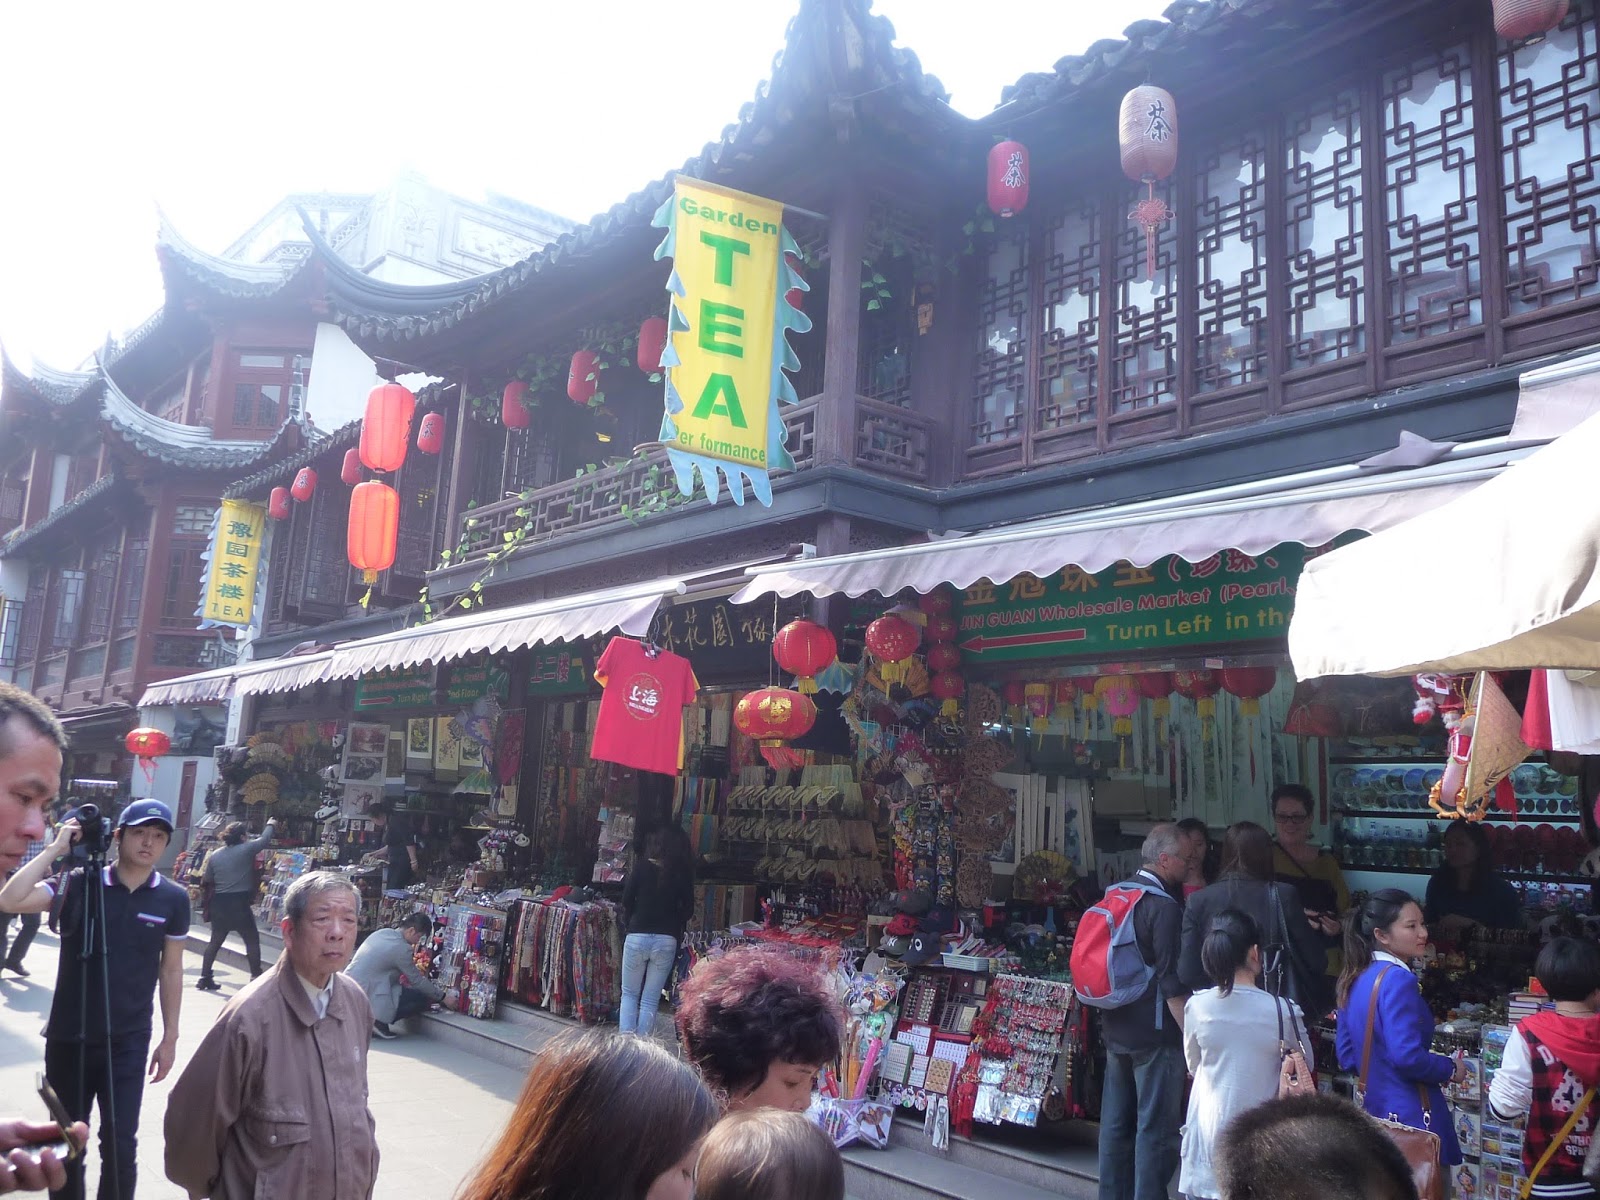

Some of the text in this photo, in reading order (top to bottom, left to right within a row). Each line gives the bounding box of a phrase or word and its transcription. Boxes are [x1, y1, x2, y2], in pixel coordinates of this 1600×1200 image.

[1144, 100, 1173, 143] 茶
[1001, 151, 1026, 188] 茶
[680, 197, 778, 235] Garden
[691, 229, 750, 429] TEA
[212, 602, 244, 617] TEA
[960, 614, 984, 631] JIN
[987, 608, 1035, 628] GUAN
[1039, 597, 1133, 621] Wholesale
[1138, 589, 1211, 611] Market
[1106, 624, 1157, 641] Turn
[1166, 614, 1212, 636] Left
[1226, 611, 1248, 630] in
[629, 685, 658, 706] 上海
